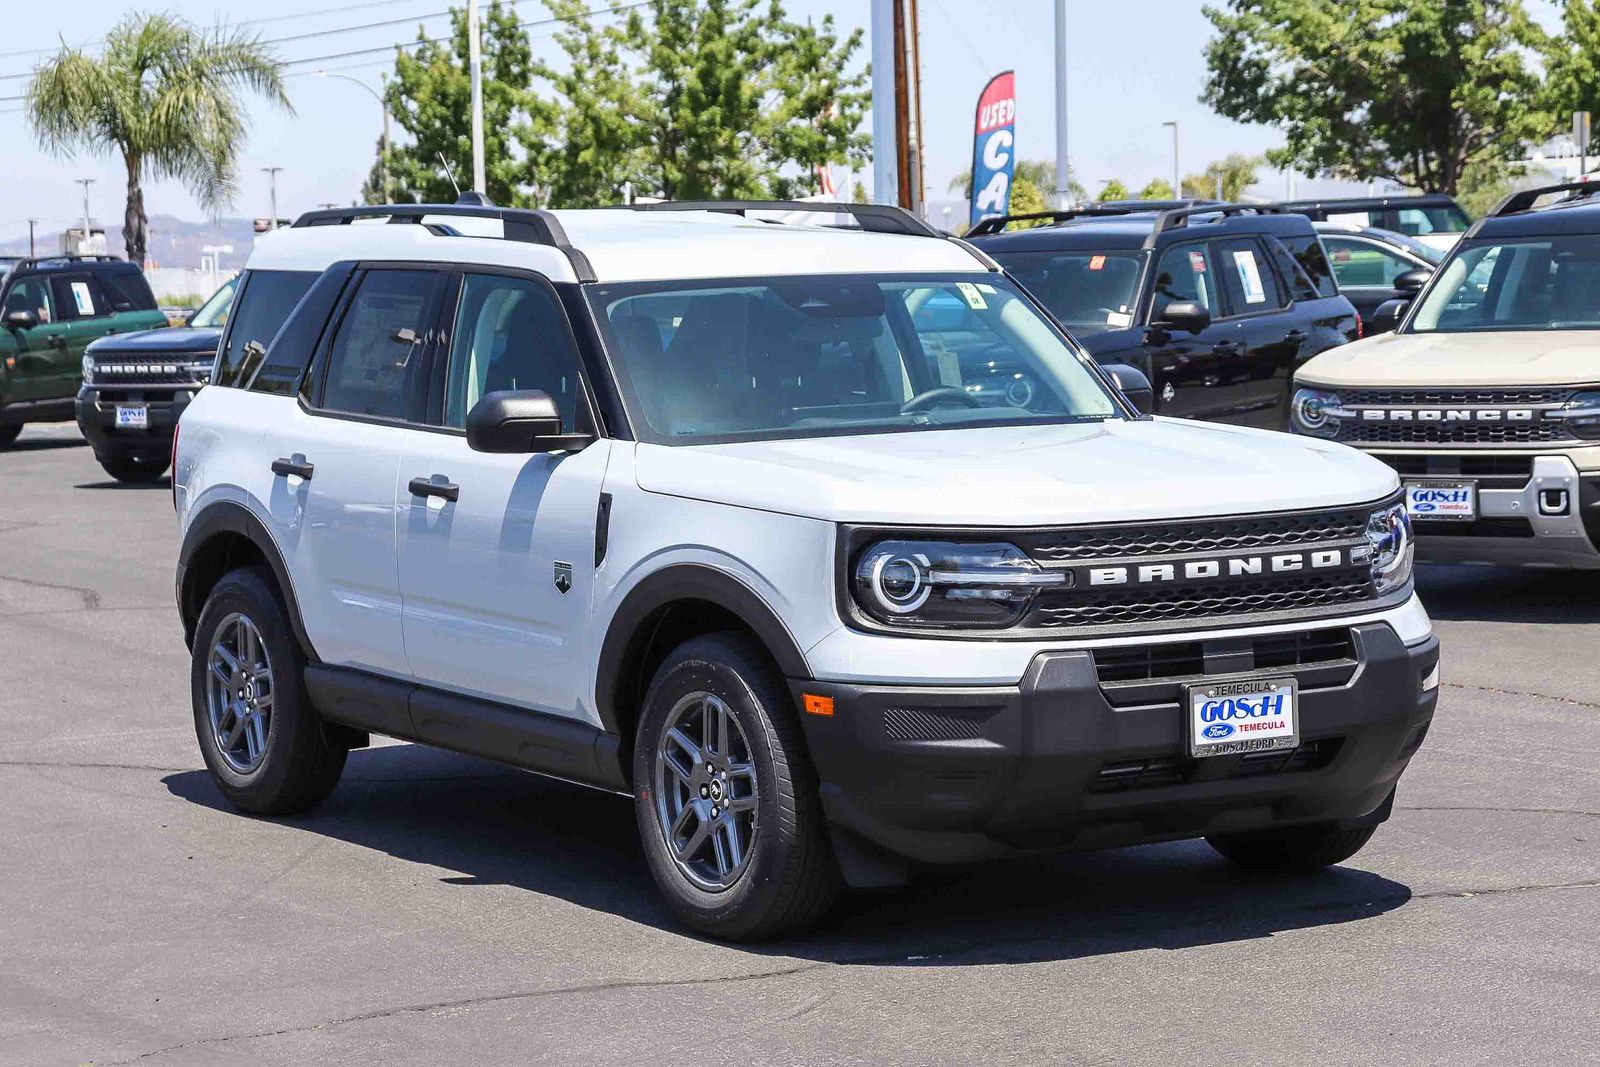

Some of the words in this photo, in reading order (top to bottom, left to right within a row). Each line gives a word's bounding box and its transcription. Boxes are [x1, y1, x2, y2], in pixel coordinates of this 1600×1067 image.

[980, 98, 1015, 129] USED
[976, 129, 1013, 220] CA
[101, 365, 177, 374] BRONCO
[1363, 410, 1533, 421] BRONCO
[1089, 550, 1342, 586] BRONCO
[1215, 682, 1271, 696] TEMECULA
[1239, 720, 1286, 732] TEMECULA
